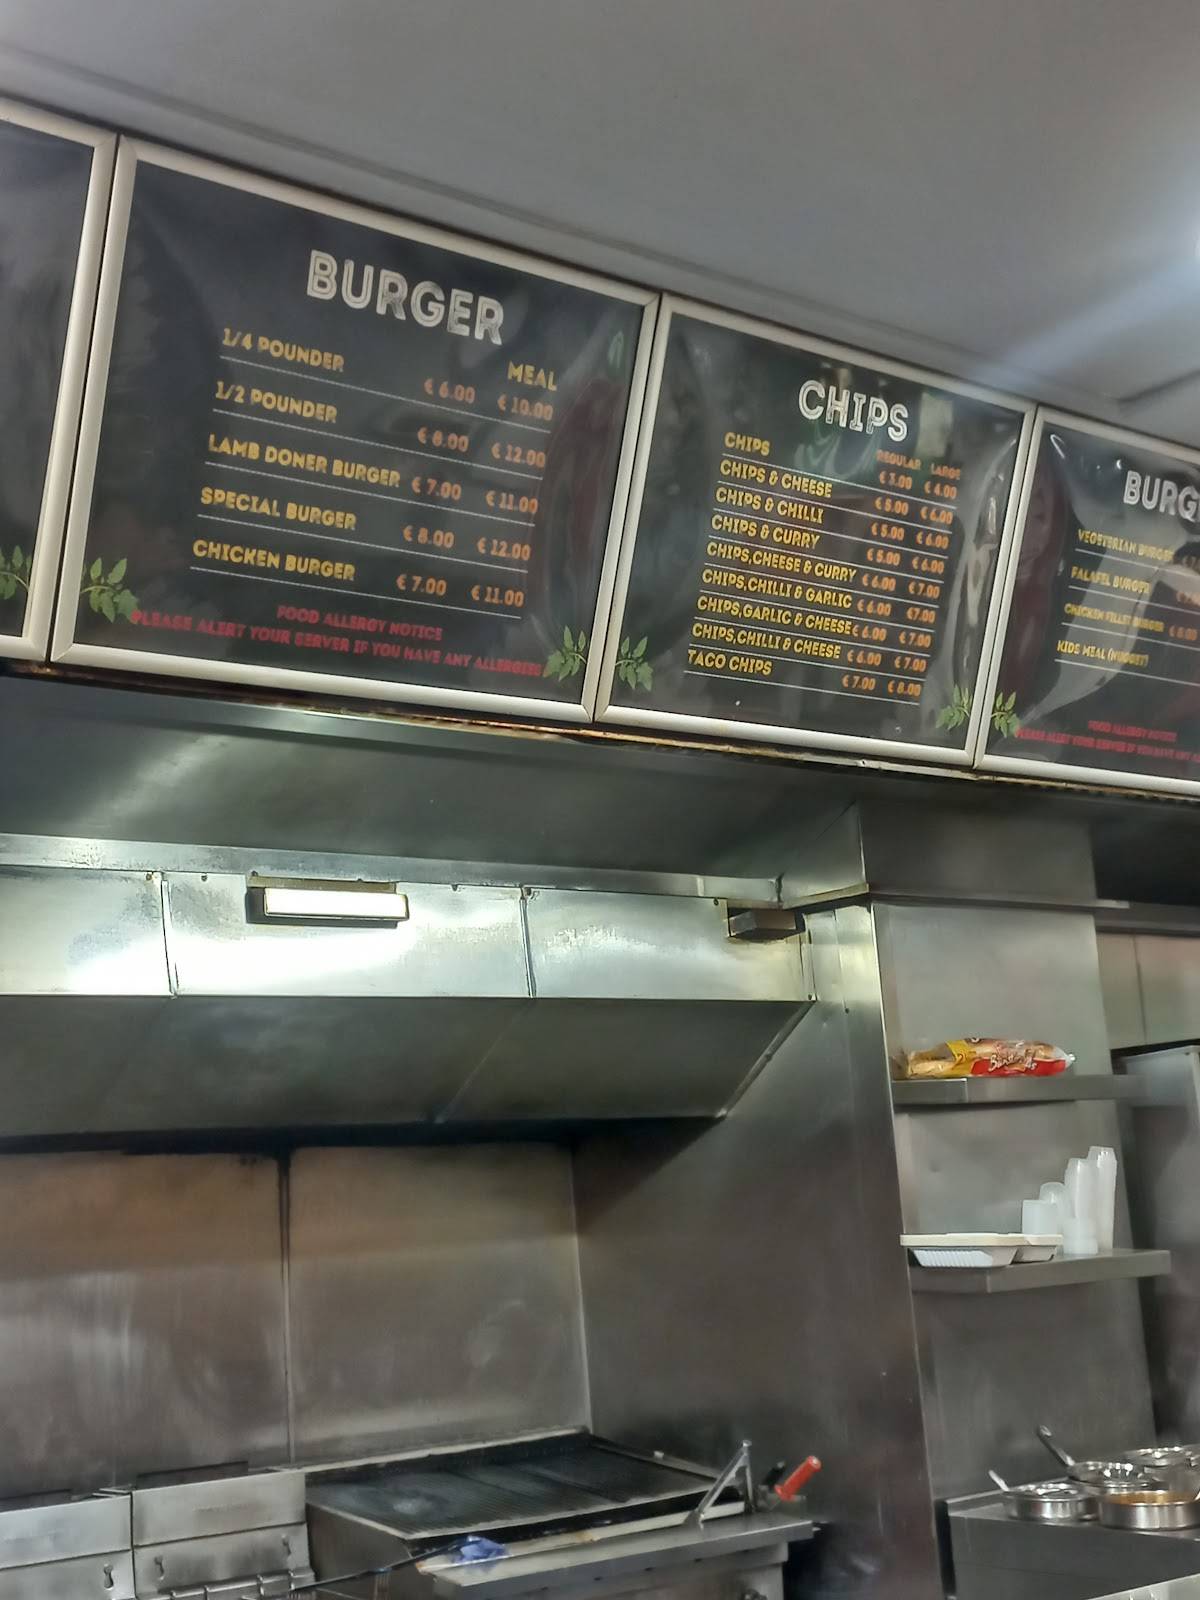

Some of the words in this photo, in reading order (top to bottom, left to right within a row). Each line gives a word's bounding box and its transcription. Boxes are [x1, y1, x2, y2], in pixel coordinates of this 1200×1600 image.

[307, 250, 503, 345] BURGER
[222, 327, 252, 350] 1/4
[258, 336, 344, 372] POUNDER
[511, 396, 553, 421] 10.00
[507, 360, 557, 391] MEAL
[215, 381, 245, 403] 1/2
[250, 388, 337, 423] POUNDER
[505, 444, 545, 468] 12.00
[798, 379, 909, 442] CHIPS
[724, 431, 770, 456] CHIPS
[208, 434, 260, 460] LAMB
[265, 445, 328, 474] DONER
[332, 459, 400, 487] BURGER
[427, 478, 462, 500] 7.00
[499, 492, 538, 515] 11.00
[720, 459, 766, 484] CHIPS
[768, 470, 778, 486] &
[781, 473, 833, 498] CHEESE
[715, 486, 762, 511] CHIPS
[764, 497, 774, 513] &
[777, 500, 824, 524] CHILLI
[1123, 470, 1200, 522] BURG
[200, 486, 281, 518] SPECIAL
[285, 502, 357, 531] BURGER
[417, 527, 454, 548] 8.00
[490, 539, 531, 561] 12.00
[711, 514, 757, 538] CHIPS
[760, 524, 770, 540] &
[772, 527, 821, 549] CURRY
[193, 539, 279, 569] CHICKEN
[285, 554, 356, 582] BURGER
[412, 575, 447, 596] 7.00
[484, 586, 524, 607] 11.00
[803, 560, 812, 574] &
[814, 562, 857, 583] CURRY
[872, 575, 896, 592] 6.00
[918, 583, 940, 599] 7.00
[794, 586, 803, 600] &
[805, 588, 853, 609] GARLIC
[276, 604, 320, 624] FOOD
[323, 613, 387, 633] ALLERGY
[389, 621, 443, 641] NOTICE
[794, 612, 803, 626] &
[805, 614, 852, 635] CHEESE
[862, 625, 887, 642] 6.00
[909, 632, 932, 648] 7.00
[196, 619, 246, 638] ALERT
[250, 626, 292, 645] YOUR
[294, 632, 349, 653] SERVER
[354, 639, 369, 655] IF
[371, 642, 400, 657] YOU
[404, 646, 441, 664] HAVE
[442, 652, 472, 668] ANY
[782, 637, 792, 651] &
[794, 639, 841, 660] CHEESE
[856, 651, 882, 666] 6.00
[904, 657, 927, 673] 7.00
[1056, 639, 1080, 655] KIDS
[1082, 644, 1105, 659] MEAL
[687, 649, 726, 669] TACO
[729, 655, 773, 676] CHIPS
[852, 675, 876, 690] 7.00
